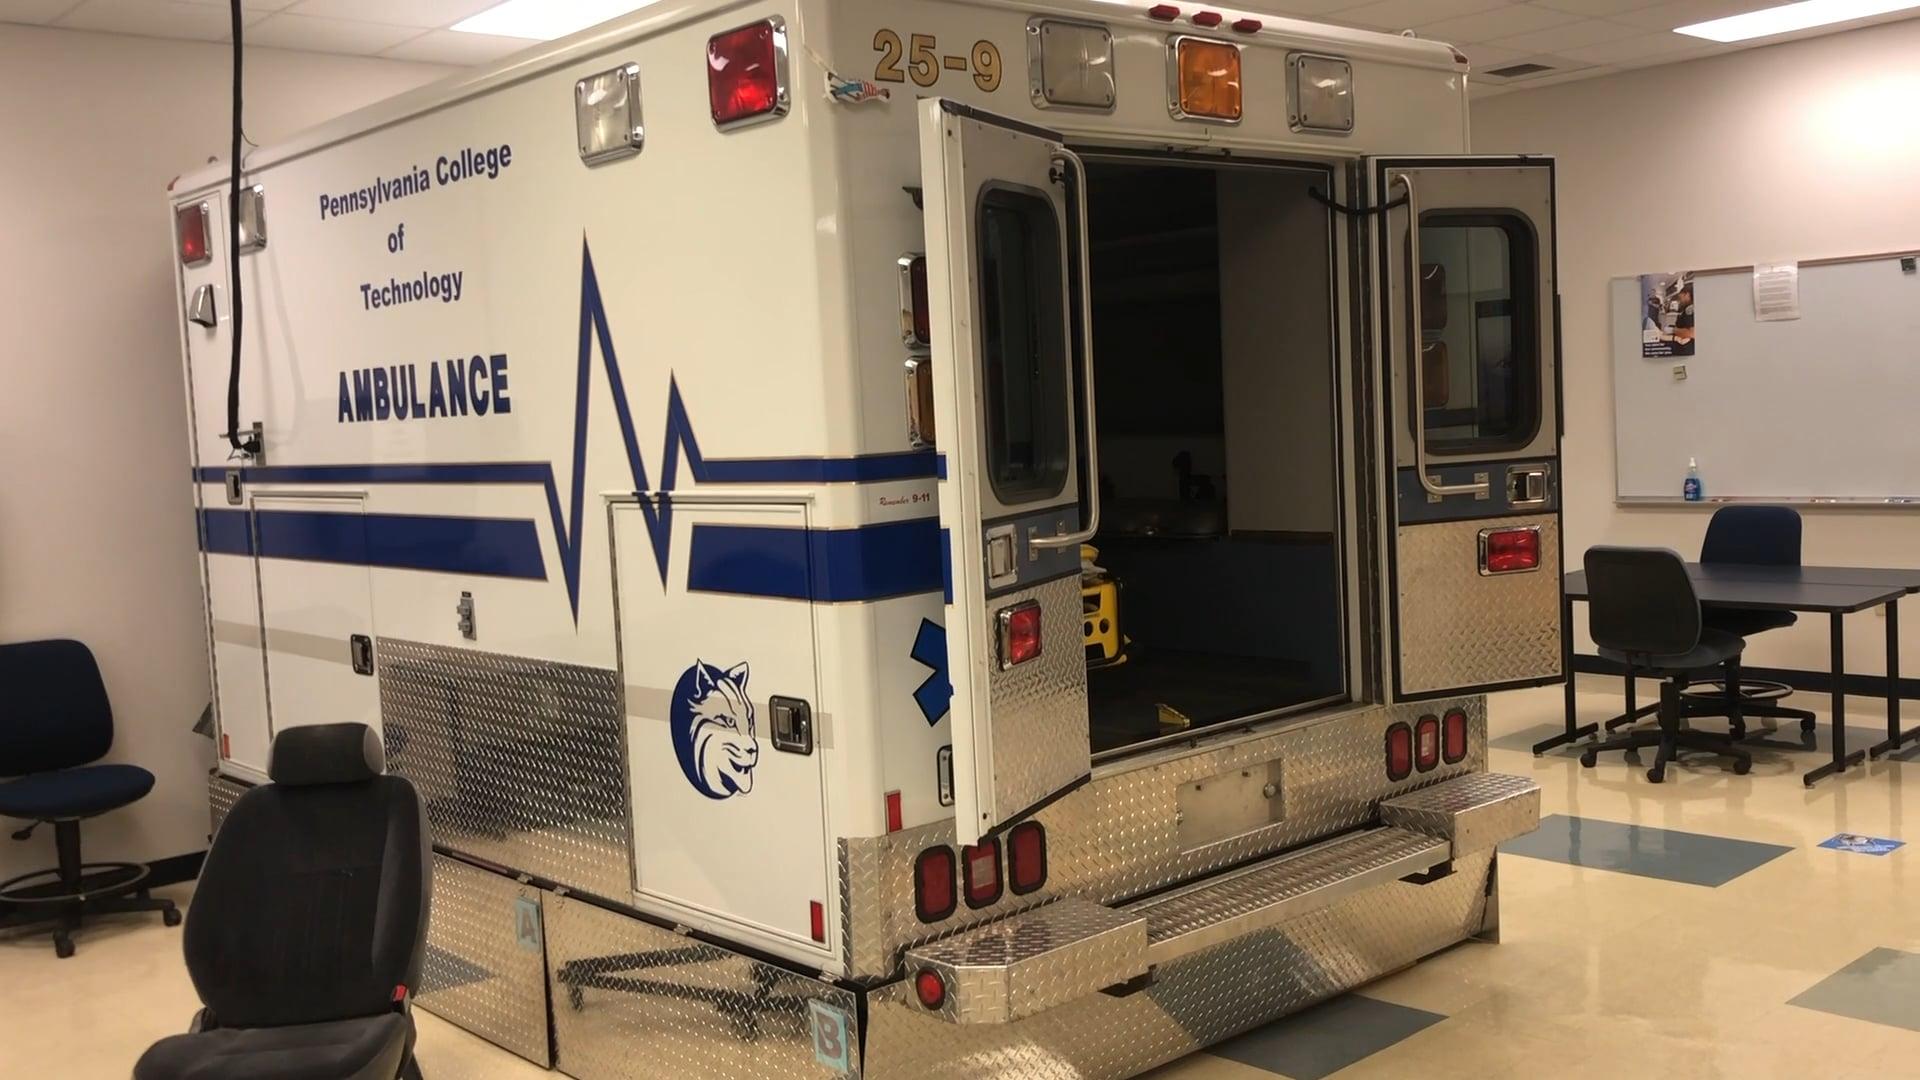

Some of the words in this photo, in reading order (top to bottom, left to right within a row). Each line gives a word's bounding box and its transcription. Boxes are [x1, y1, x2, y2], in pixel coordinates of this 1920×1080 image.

[873, 28, 1002, 92] 25-9
[319, 165, 430, 220] Pennsylvania
[435, 144, 512, 186] College
[387, 222, 404, 253] of
[360, 270, 463, 310] Technology
[338, 353, 511, 423] AMBULANCE
[912, 493, 930, 503] 9-11
[521, 908, 537, 944] A
[816, 1011, 842, 1060] B
